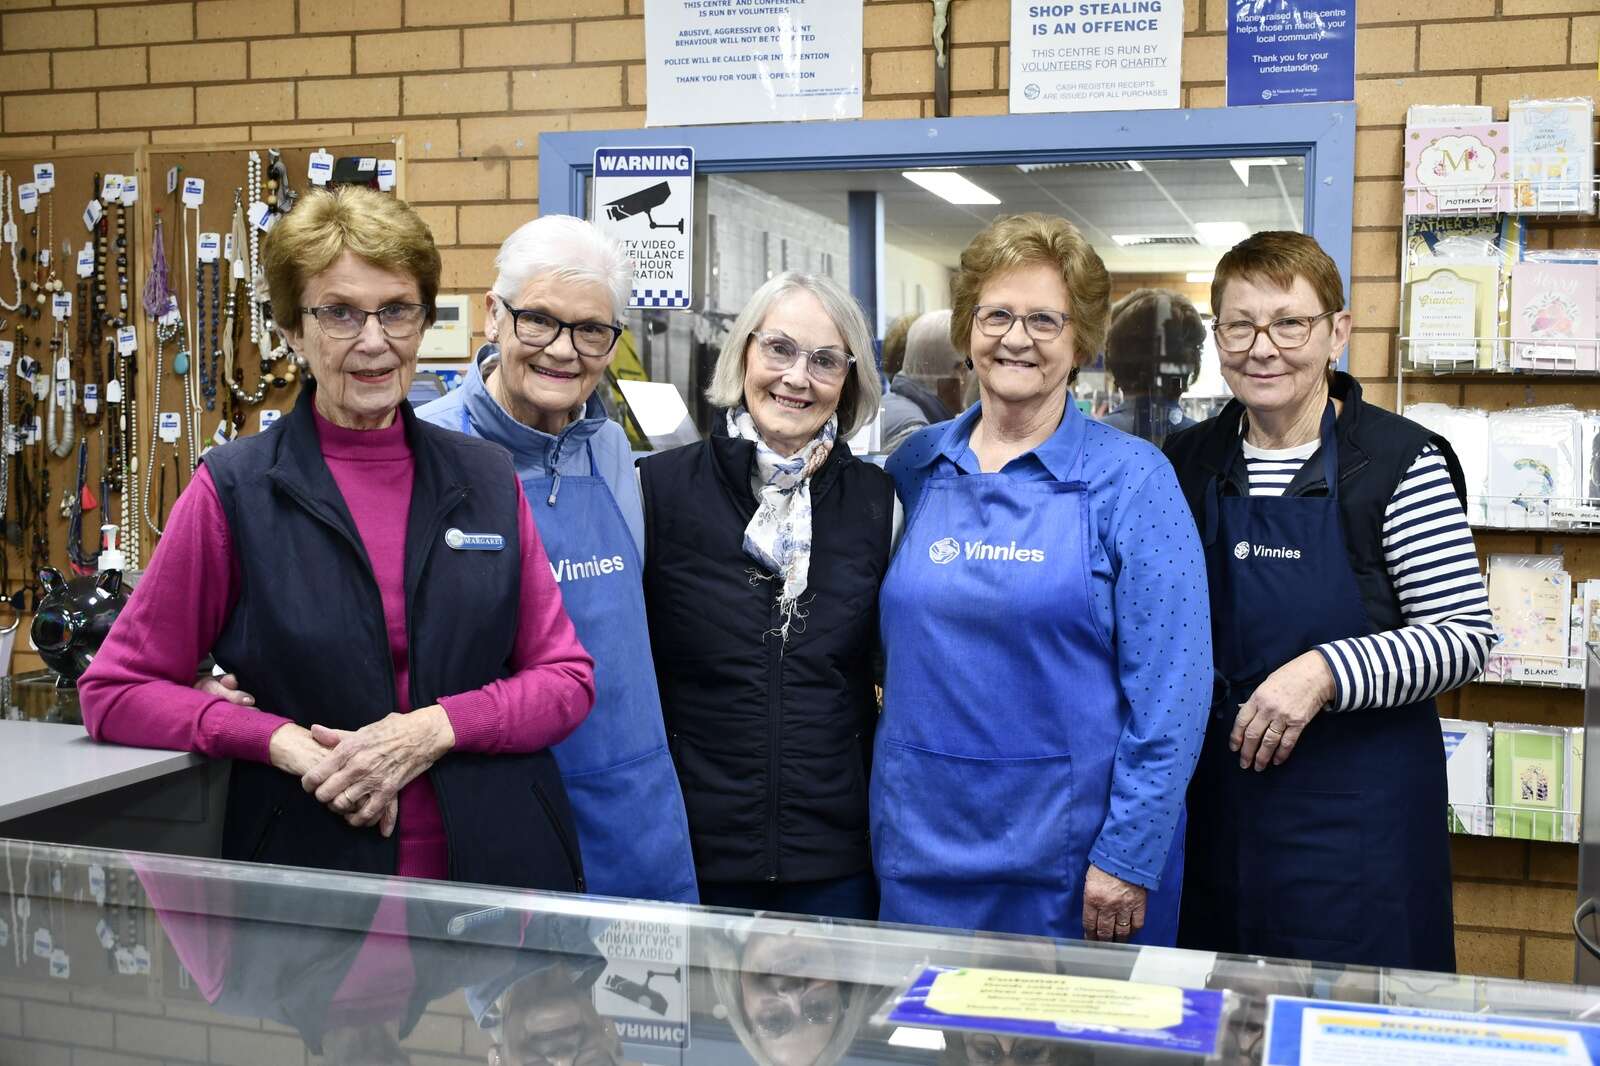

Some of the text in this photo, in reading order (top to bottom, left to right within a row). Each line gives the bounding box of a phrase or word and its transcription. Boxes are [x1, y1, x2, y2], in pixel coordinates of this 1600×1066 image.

[703, 0, 732, 8] CENTRE
[1029, 1, 1162, 18] SHOP STEALING
[709, 9, 725, 17] RUN
[738, 7, 790, 15] VOLUNTEERS
[1236, 14, 1264, 23] Money
[1266, 12, 1291, 21] raised
[1303, 10, 1319, 19] this
[1319, 9, 1346, 18] centre
[679, 29, 712, 37] ABUSIVE,
[714, 26, 762, 35] AGGRESSIVE
[1032, 19, 1158, 36] IS AN OFFENCE
[1236, 26, 1258, 34] helps
[1260, 24, 1283, 32] those
[1285, 22, 1293, 30] in
[1294, 21, 1316, 30] need
[1327, 20, 1346, 30] your
[675, 39, 718, 47] BEHAVIOUR
[1256, 34, 1276, 43] local
[1032, 45, 1158, 58] THIS CENTRE IS RUN BY
[664, 58, 690, 66] POLICE
[771, 53, 830, 61] INTENTION
[1252, 52, 1329, 64] Thank you for your
[1021, 57, 1168, 72] VOLUNTEERS FOR CHARITY
[1260, 63, 1320, 74] understanding.
[1056, 80, 1155, 91] CASH REGISTER RECEIPTS
[1059, 92, 1087, 100] ISSUED
[1089, 91, 1105, 99] FOR
[1107, 90, 1120, 98] ALL
[1121, 89, 1168, 97] PURCHASES
[600, 155, 689, 171] WARNING
[1441, 149, 1470, 171] M
[625, 240, 676, 249] TV VIDEO
[626, 250, 685, 259] EILLANCE
[640, 261, 672, 269] HOUR
[632, 270, 674, 279] RATION
[965, 540, 1045, 562] Vinnies
[1253, 544, 1301, 559] Vinnies
[549, 554, 625, 583] Vinnies
[1524, 668, 1559, 676] BLANKS
